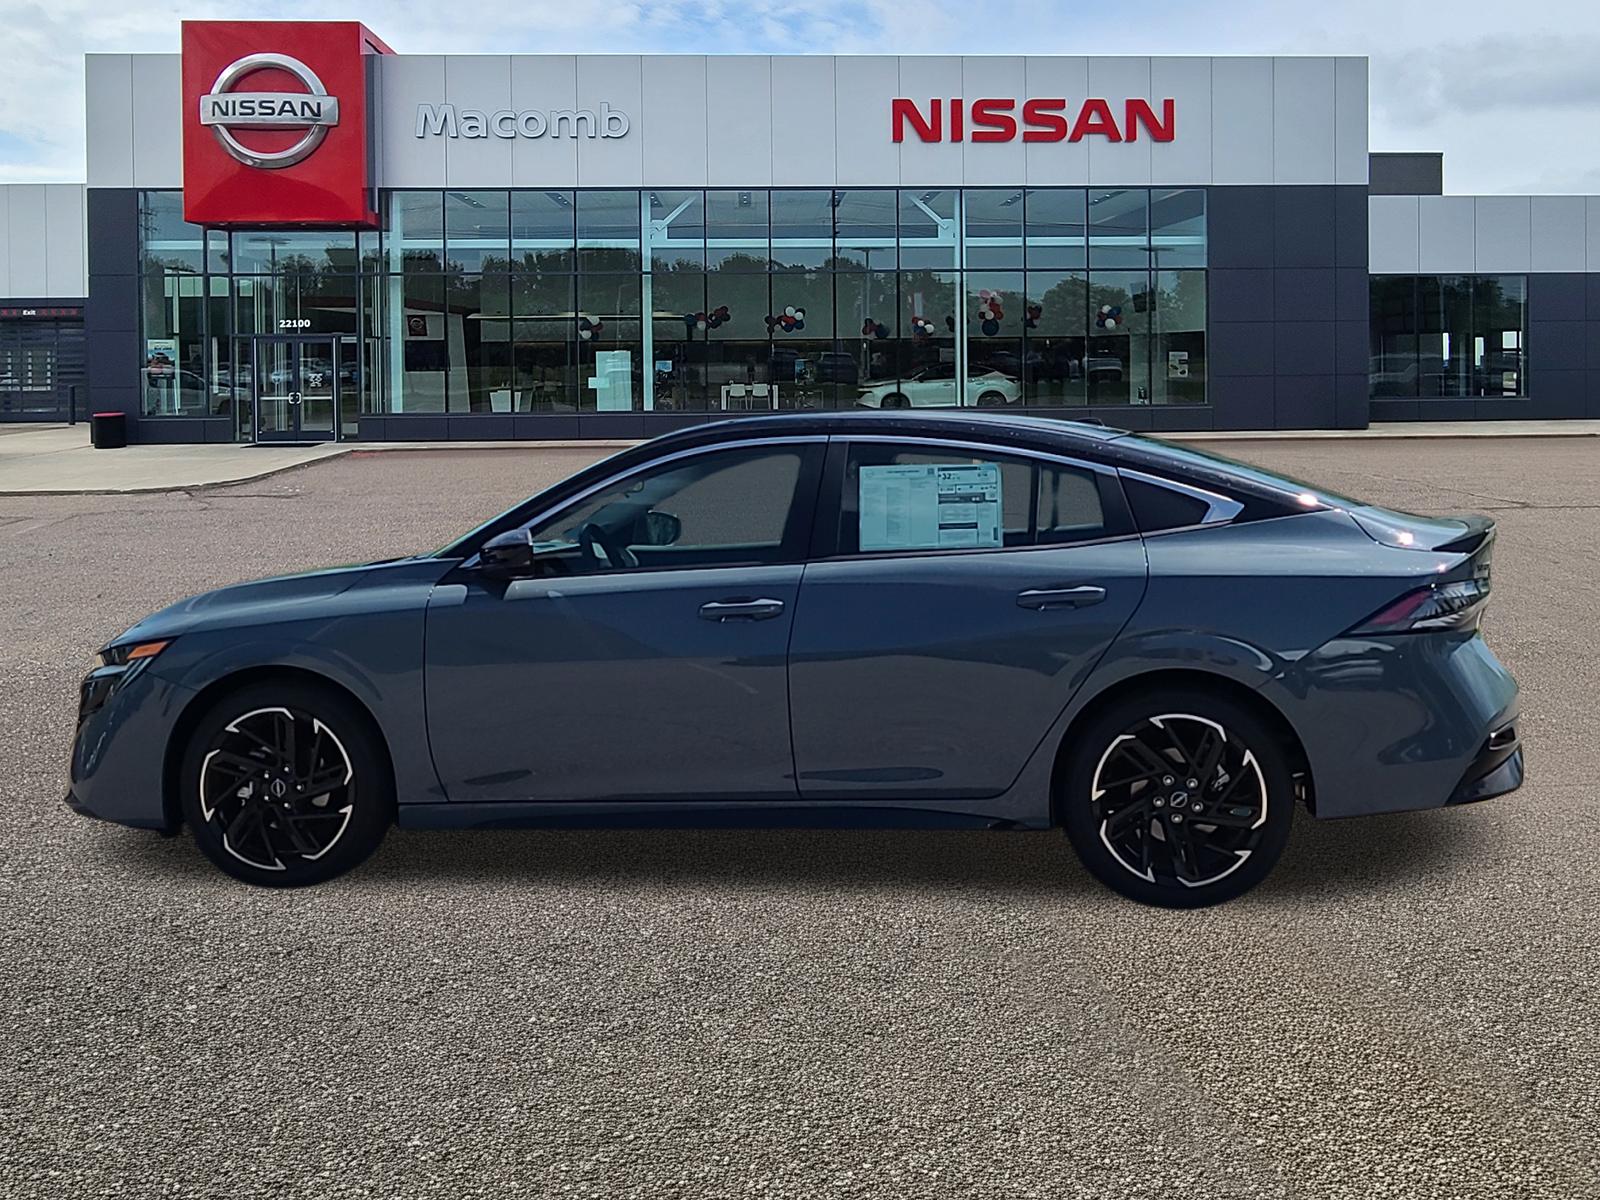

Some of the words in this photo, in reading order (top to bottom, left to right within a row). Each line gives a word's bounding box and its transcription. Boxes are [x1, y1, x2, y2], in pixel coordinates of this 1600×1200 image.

[212, 100, 321, 117] NISSAN
[415, 102, 630, 138] Macomb
[892, 98, 1175, 143] NISSAN
[279, 319, 311, 328] 22100
